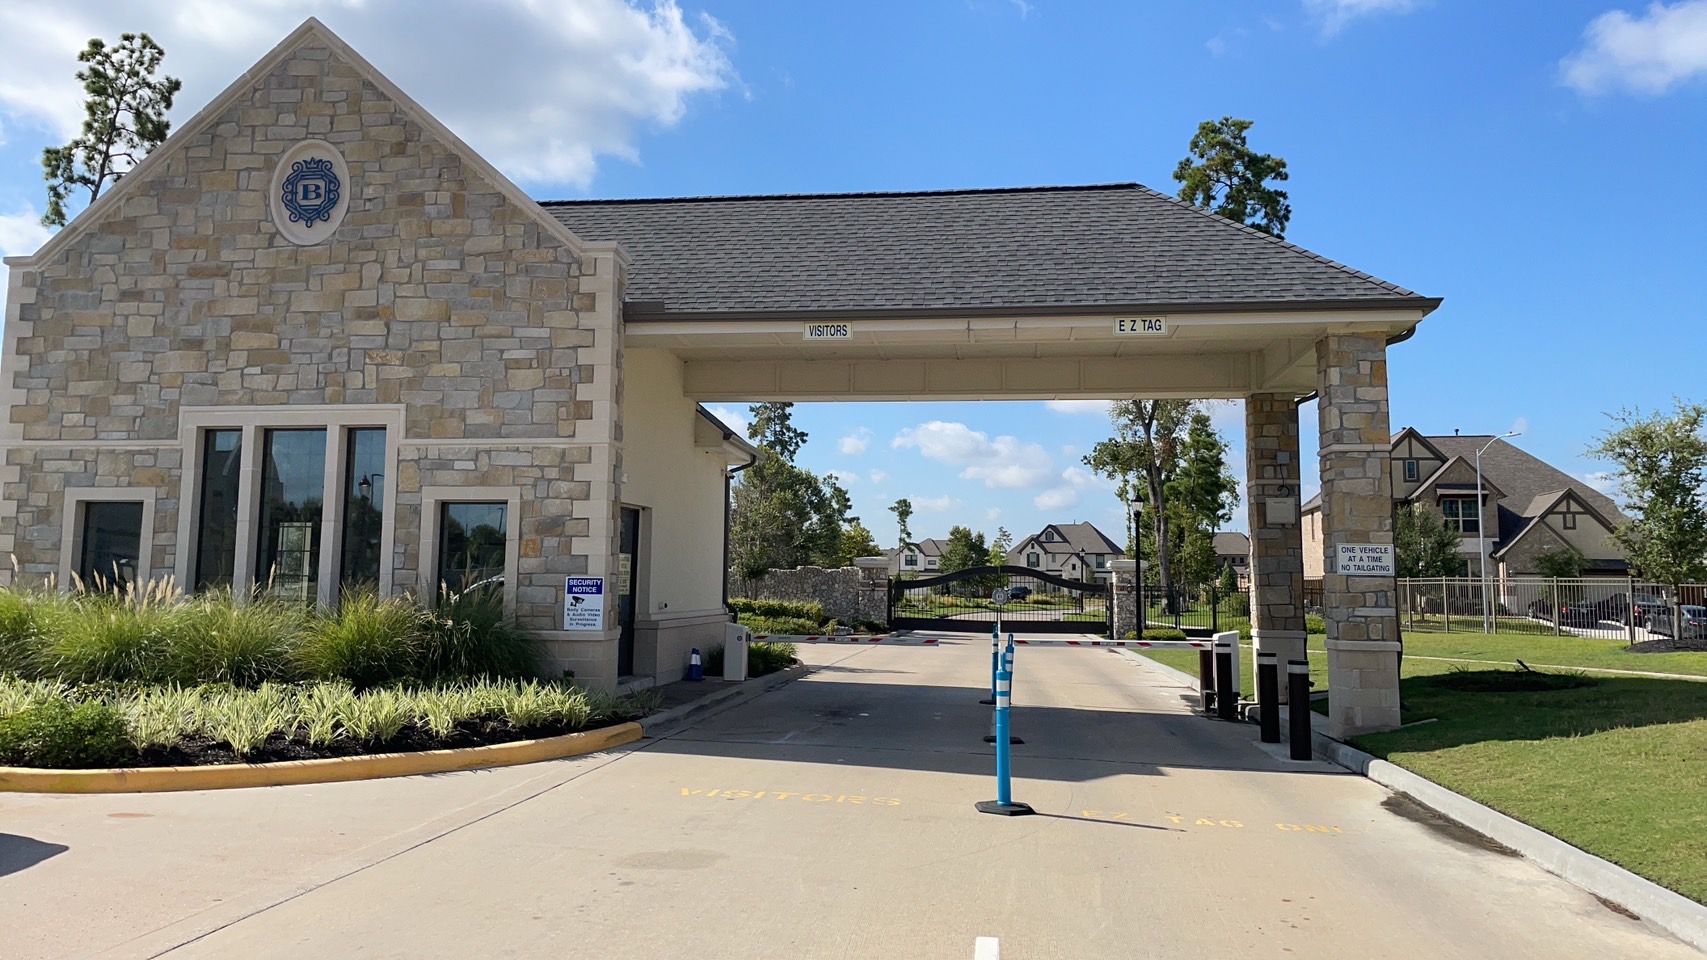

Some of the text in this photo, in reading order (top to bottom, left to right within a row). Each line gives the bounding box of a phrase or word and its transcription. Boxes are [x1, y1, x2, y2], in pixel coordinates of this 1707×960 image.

[300, 184, 322, 200] B
[809, 325, 848, 337] VISITORS
[1119, 319, 1162, 331] E Z TAG
[681, 787, 901, 806] VISITORS
